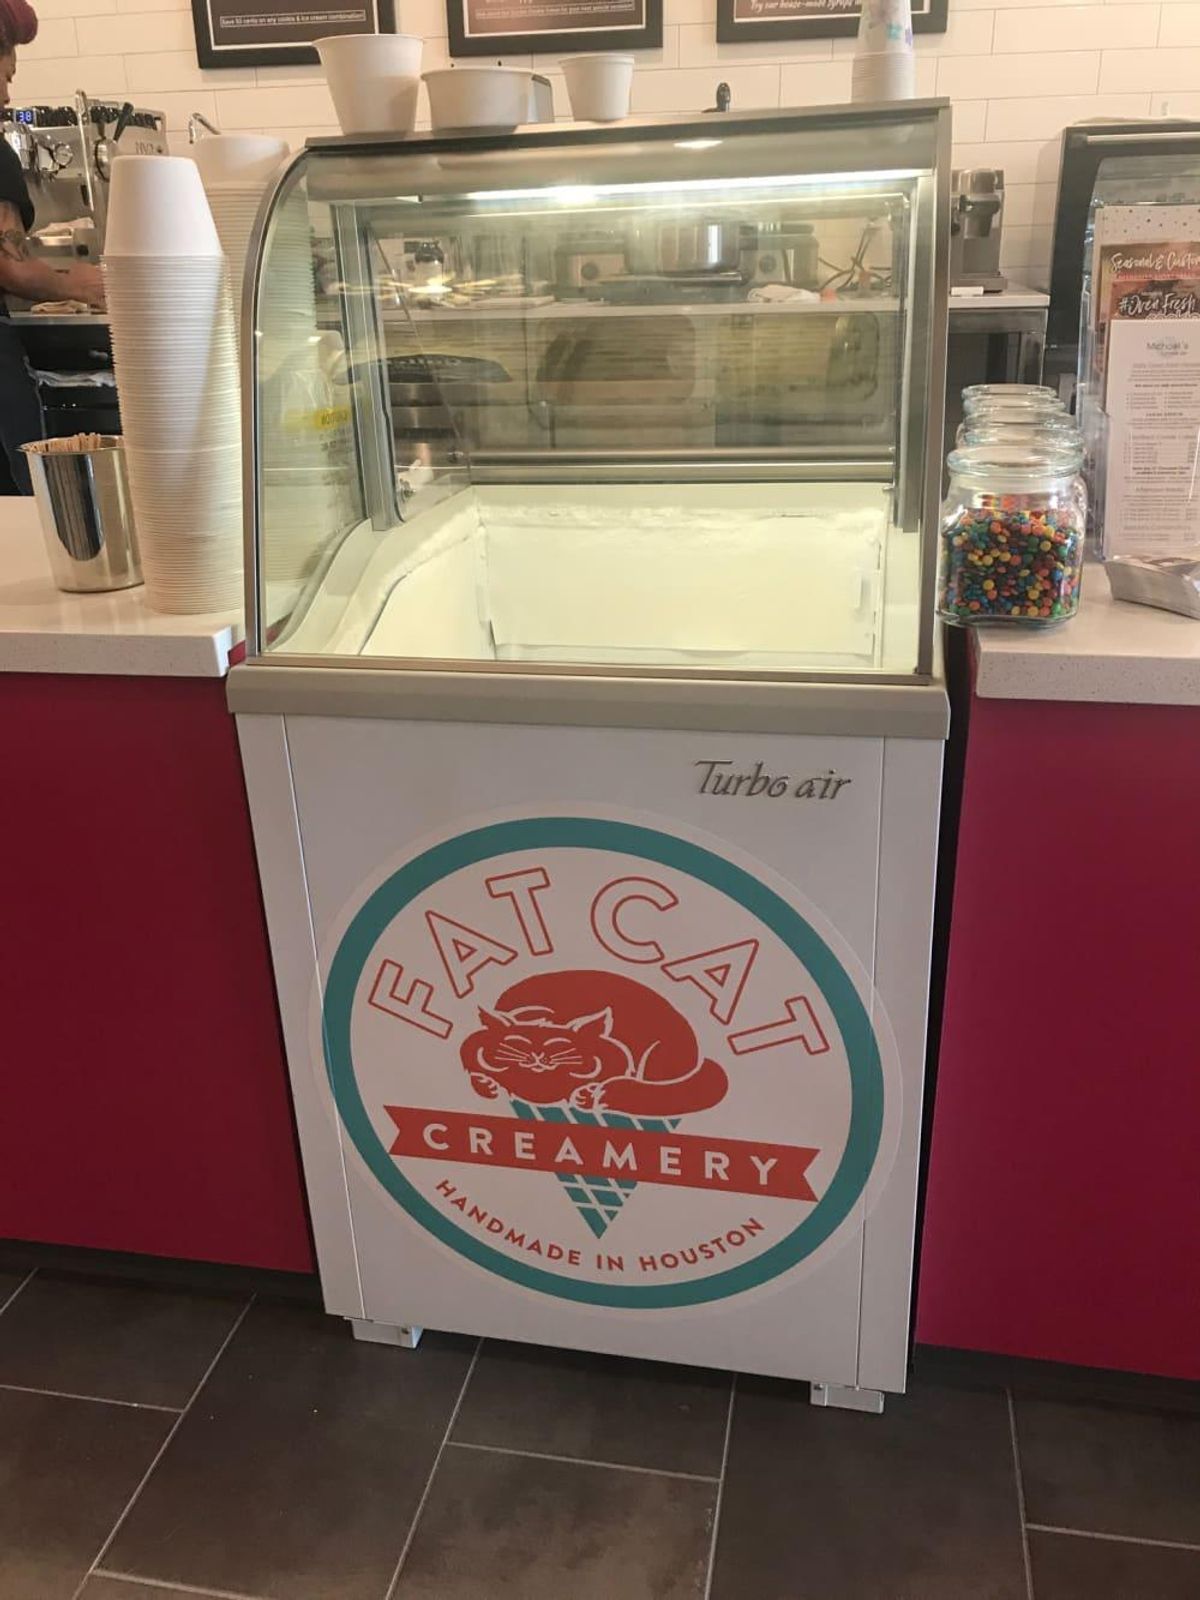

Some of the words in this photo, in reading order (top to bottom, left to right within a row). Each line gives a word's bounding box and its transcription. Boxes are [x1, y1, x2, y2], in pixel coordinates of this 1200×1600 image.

[1111, 252, 1155, 273] Seasonal
[695, 760, 791, 797] Turbo
[794, 769, 852, 800] air
[368, 867, 554, 1040] FAT
[590, 876, 831, 1055] CAT
[422, 1122, 779, 1187] CREAMERY
[435, 1179, 582, 1267] HANDMADE
[596, 1254, 625, 1272] IN
[639, 1217, 766, 1273] HOUSTON
